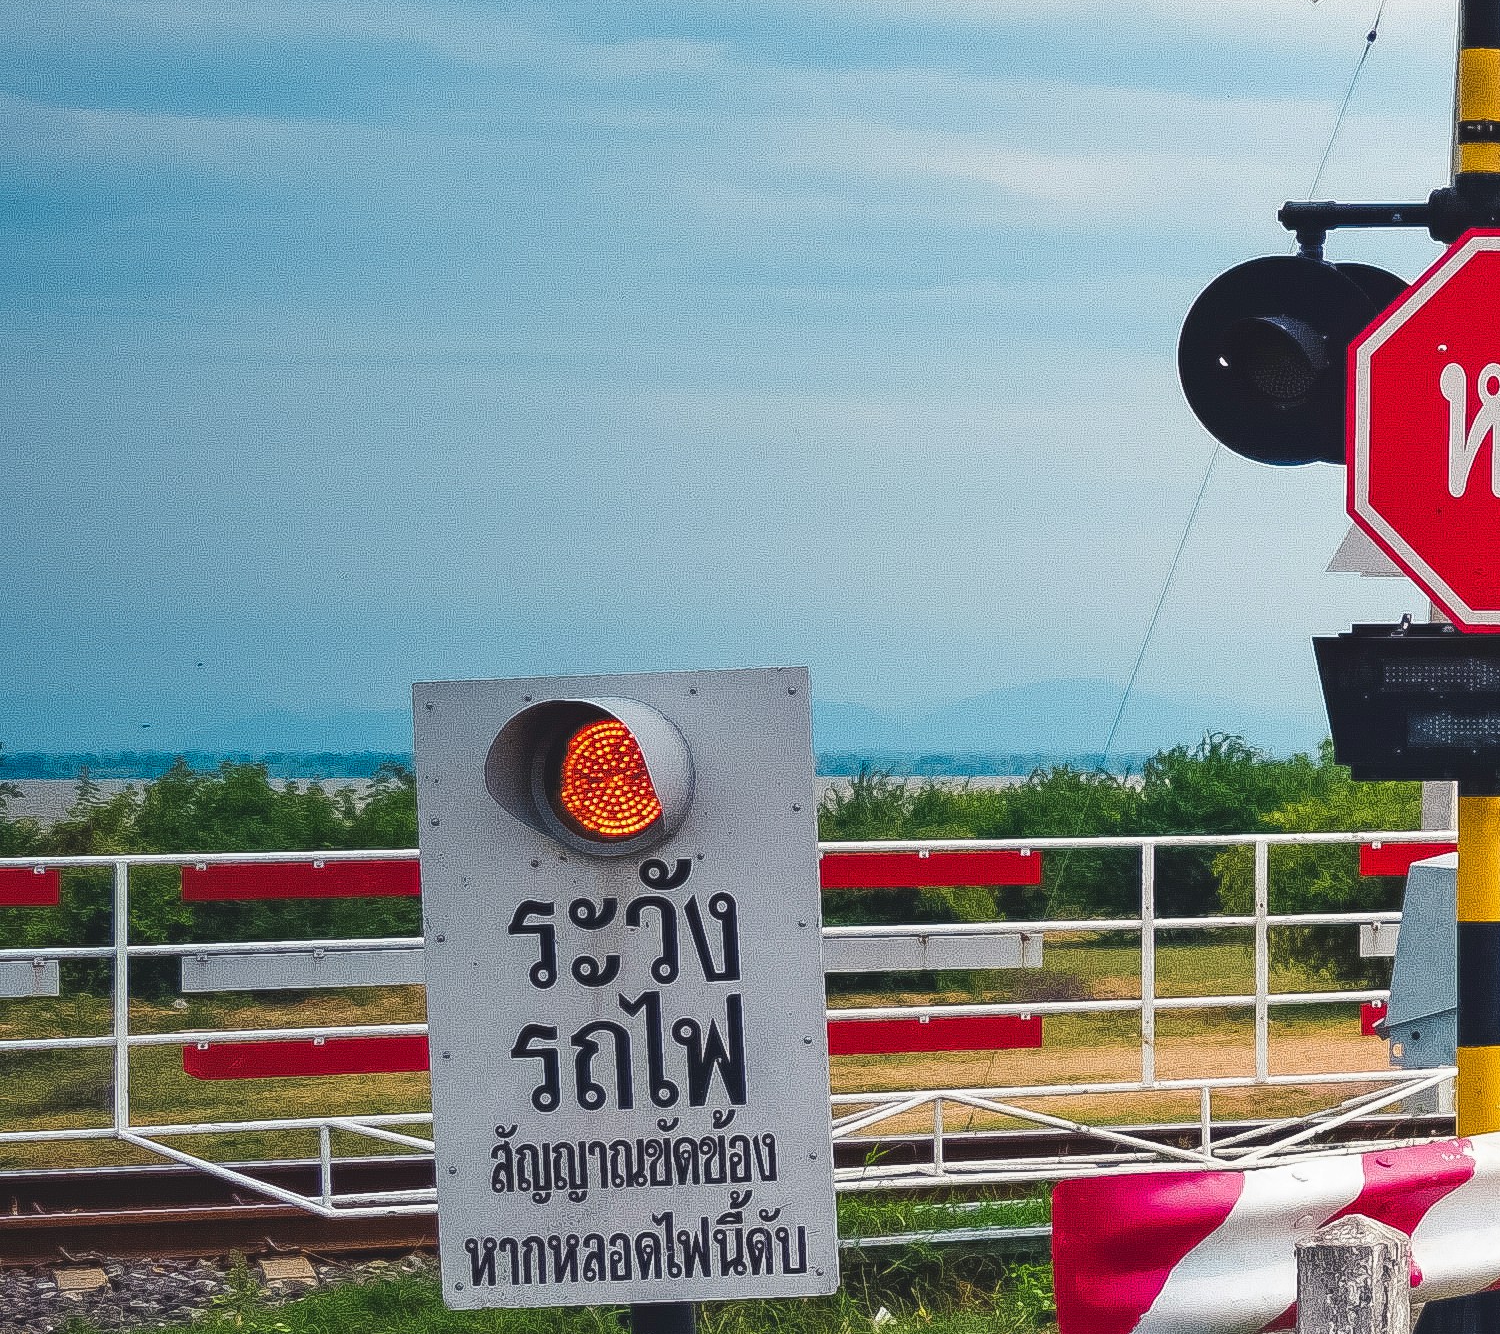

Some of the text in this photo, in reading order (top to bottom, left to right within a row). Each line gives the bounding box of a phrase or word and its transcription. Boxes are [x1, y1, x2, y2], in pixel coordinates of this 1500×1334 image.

[508, 857, 739, 988] ระวัง
[511, 993, 746, 1113] รถไฟ
[492, 1110, 776, 1204] สัญญาณขัดข้อง
[465, 1191, 806, 1285] หากหลอดไฟนี้ดับ
